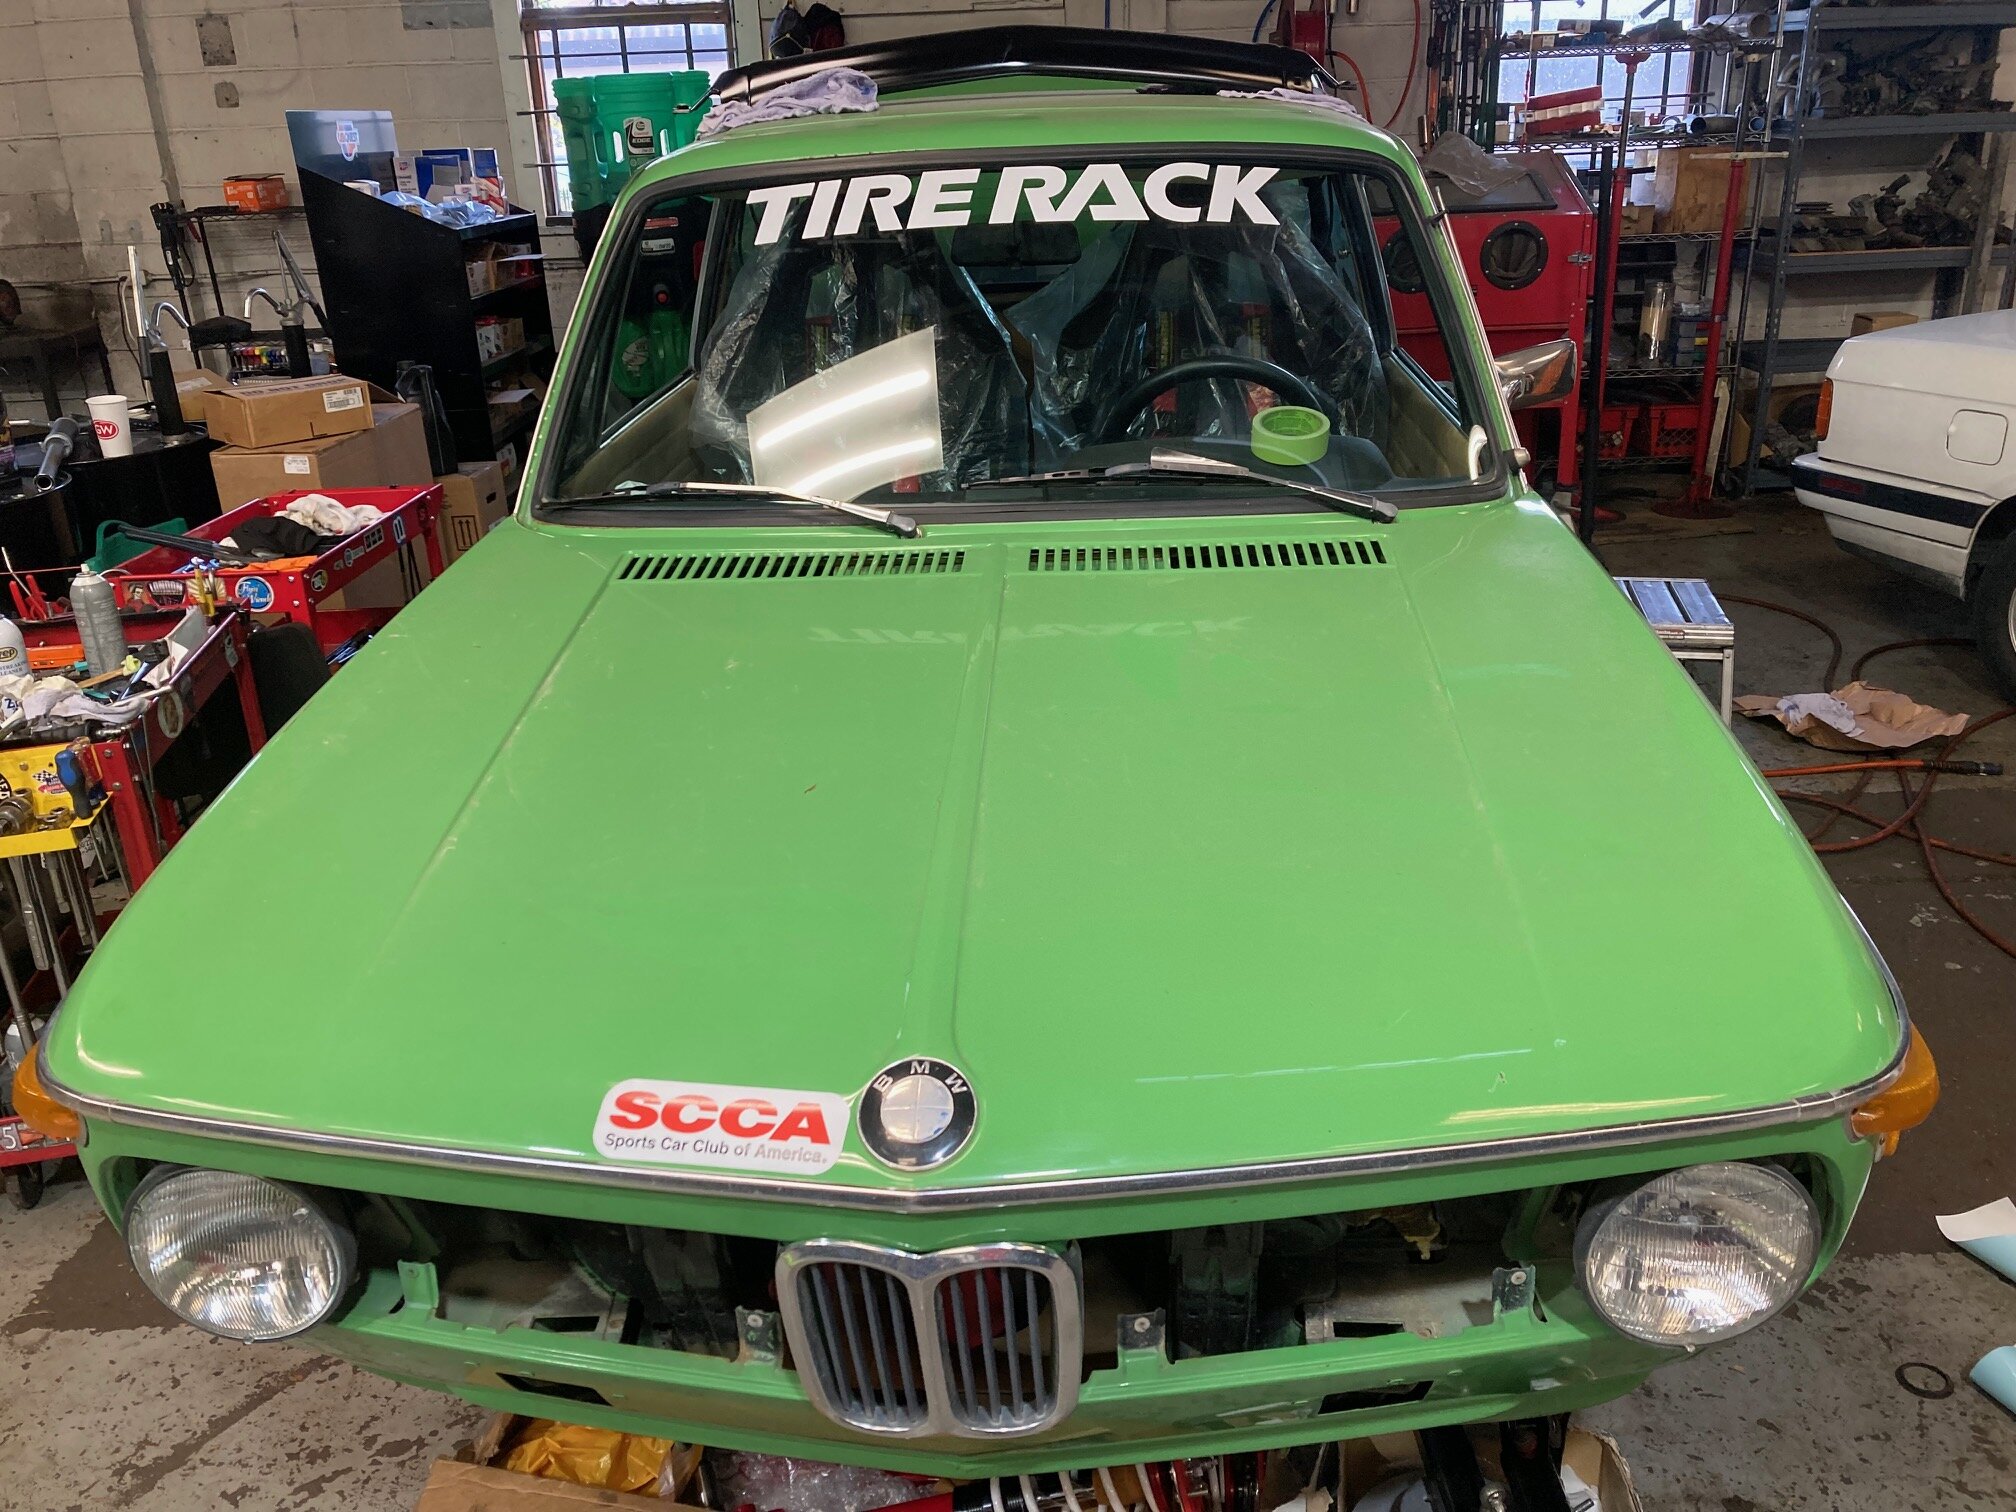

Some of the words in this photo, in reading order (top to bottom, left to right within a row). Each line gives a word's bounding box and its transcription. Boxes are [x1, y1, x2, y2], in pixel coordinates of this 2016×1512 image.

[746, 168, 981, 245] TIRE
[988, 162, 1280, 226] RACK
[872, 1060, 968, 1094] BMW
[609, 1090, 831, 1146] SCCA
[604, 1133, 655, 1151] Sports
[661, 1137, 687, 1152] Car
[693, 1139, 729, 1155] Club
[734, 1142, 752, 1157] of
